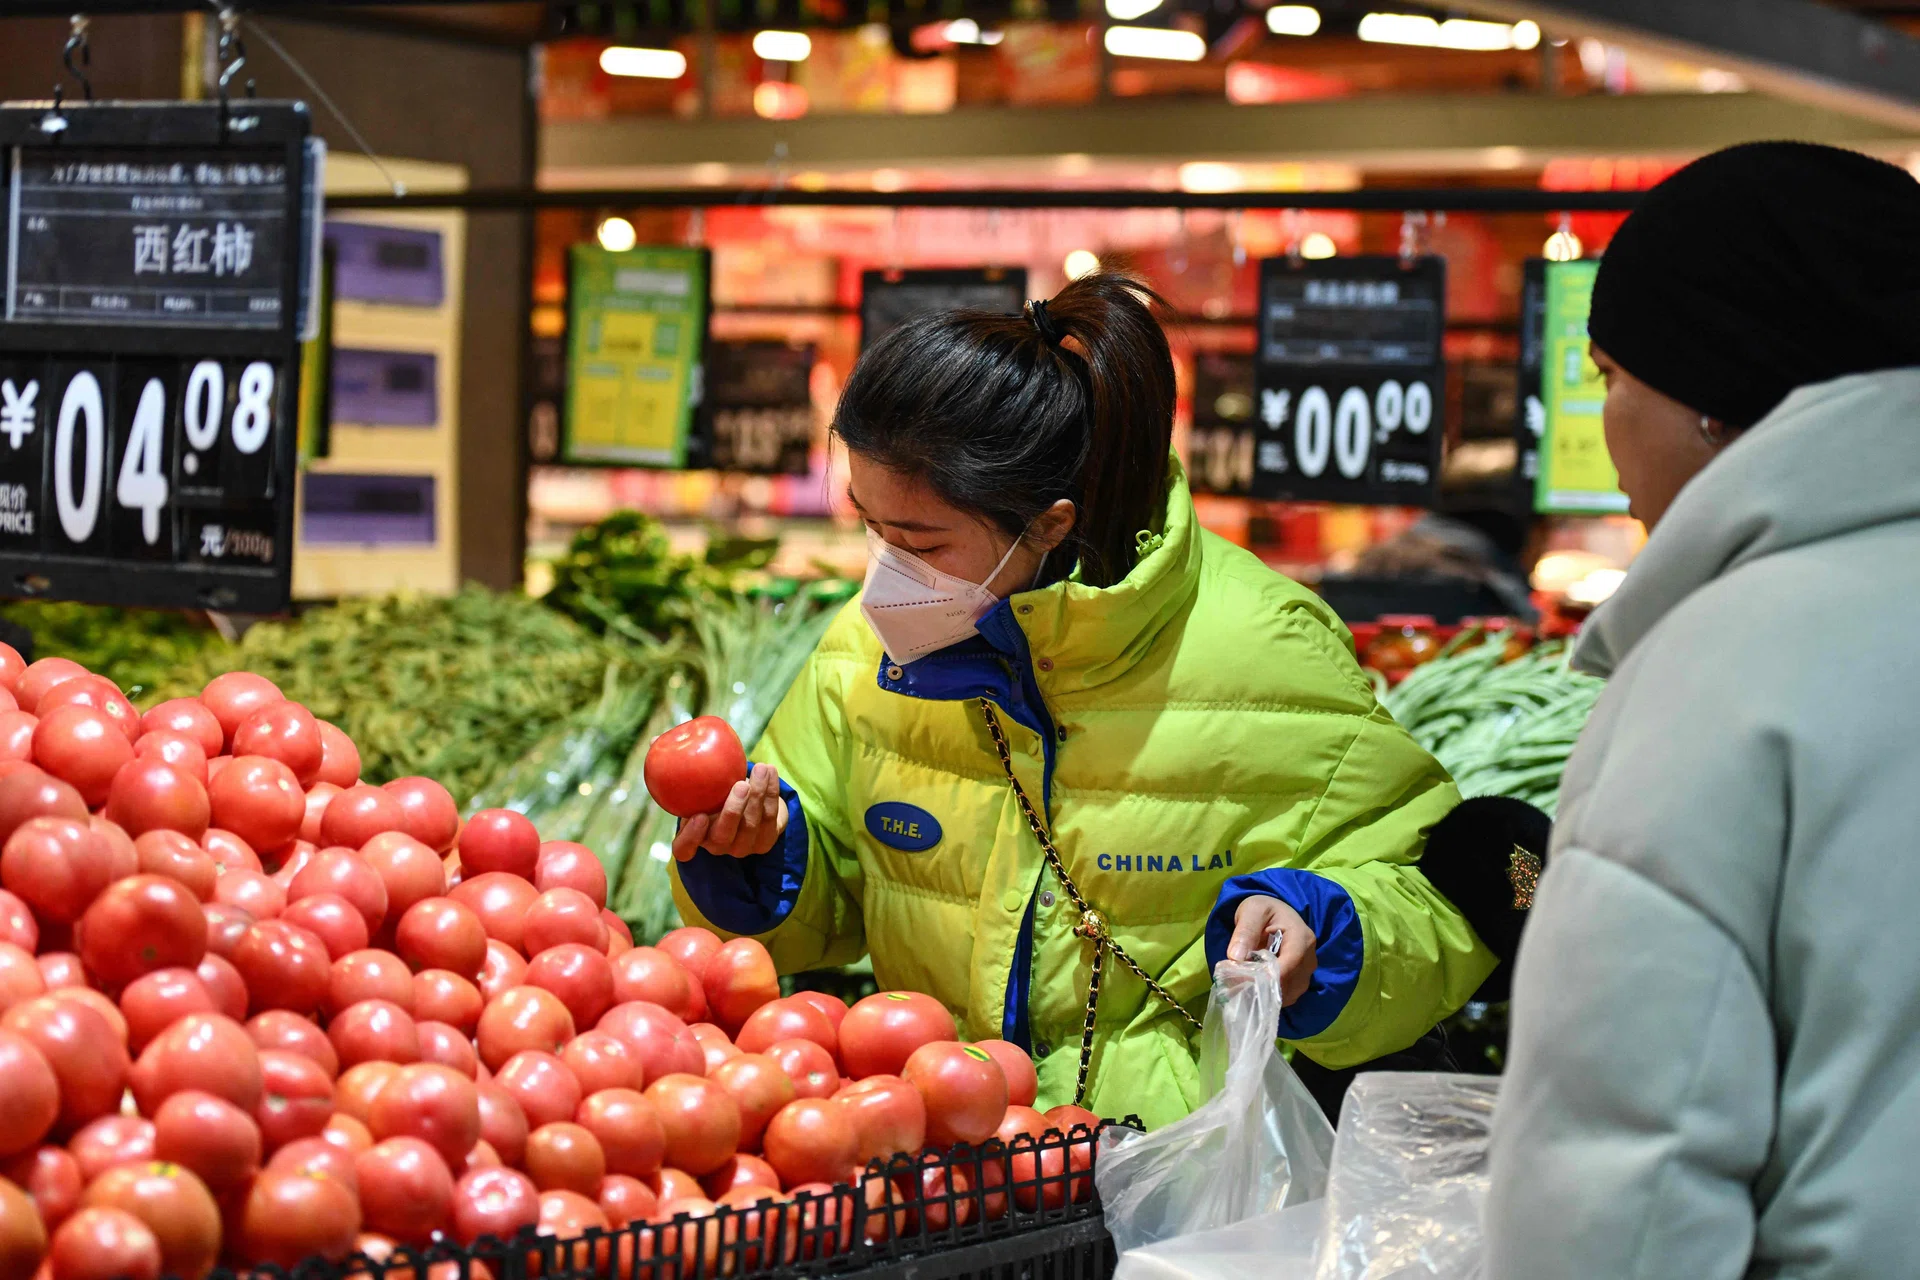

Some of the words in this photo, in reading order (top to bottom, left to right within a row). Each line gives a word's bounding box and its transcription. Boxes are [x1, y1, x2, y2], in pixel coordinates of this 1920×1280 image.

[133, 222, 254, 277] 西红柿
[880, 816, 922, 839] T.H.E.
[1097, 853, 1183, 872] CHINA
[1192, 850, 1233, 871] LAI
